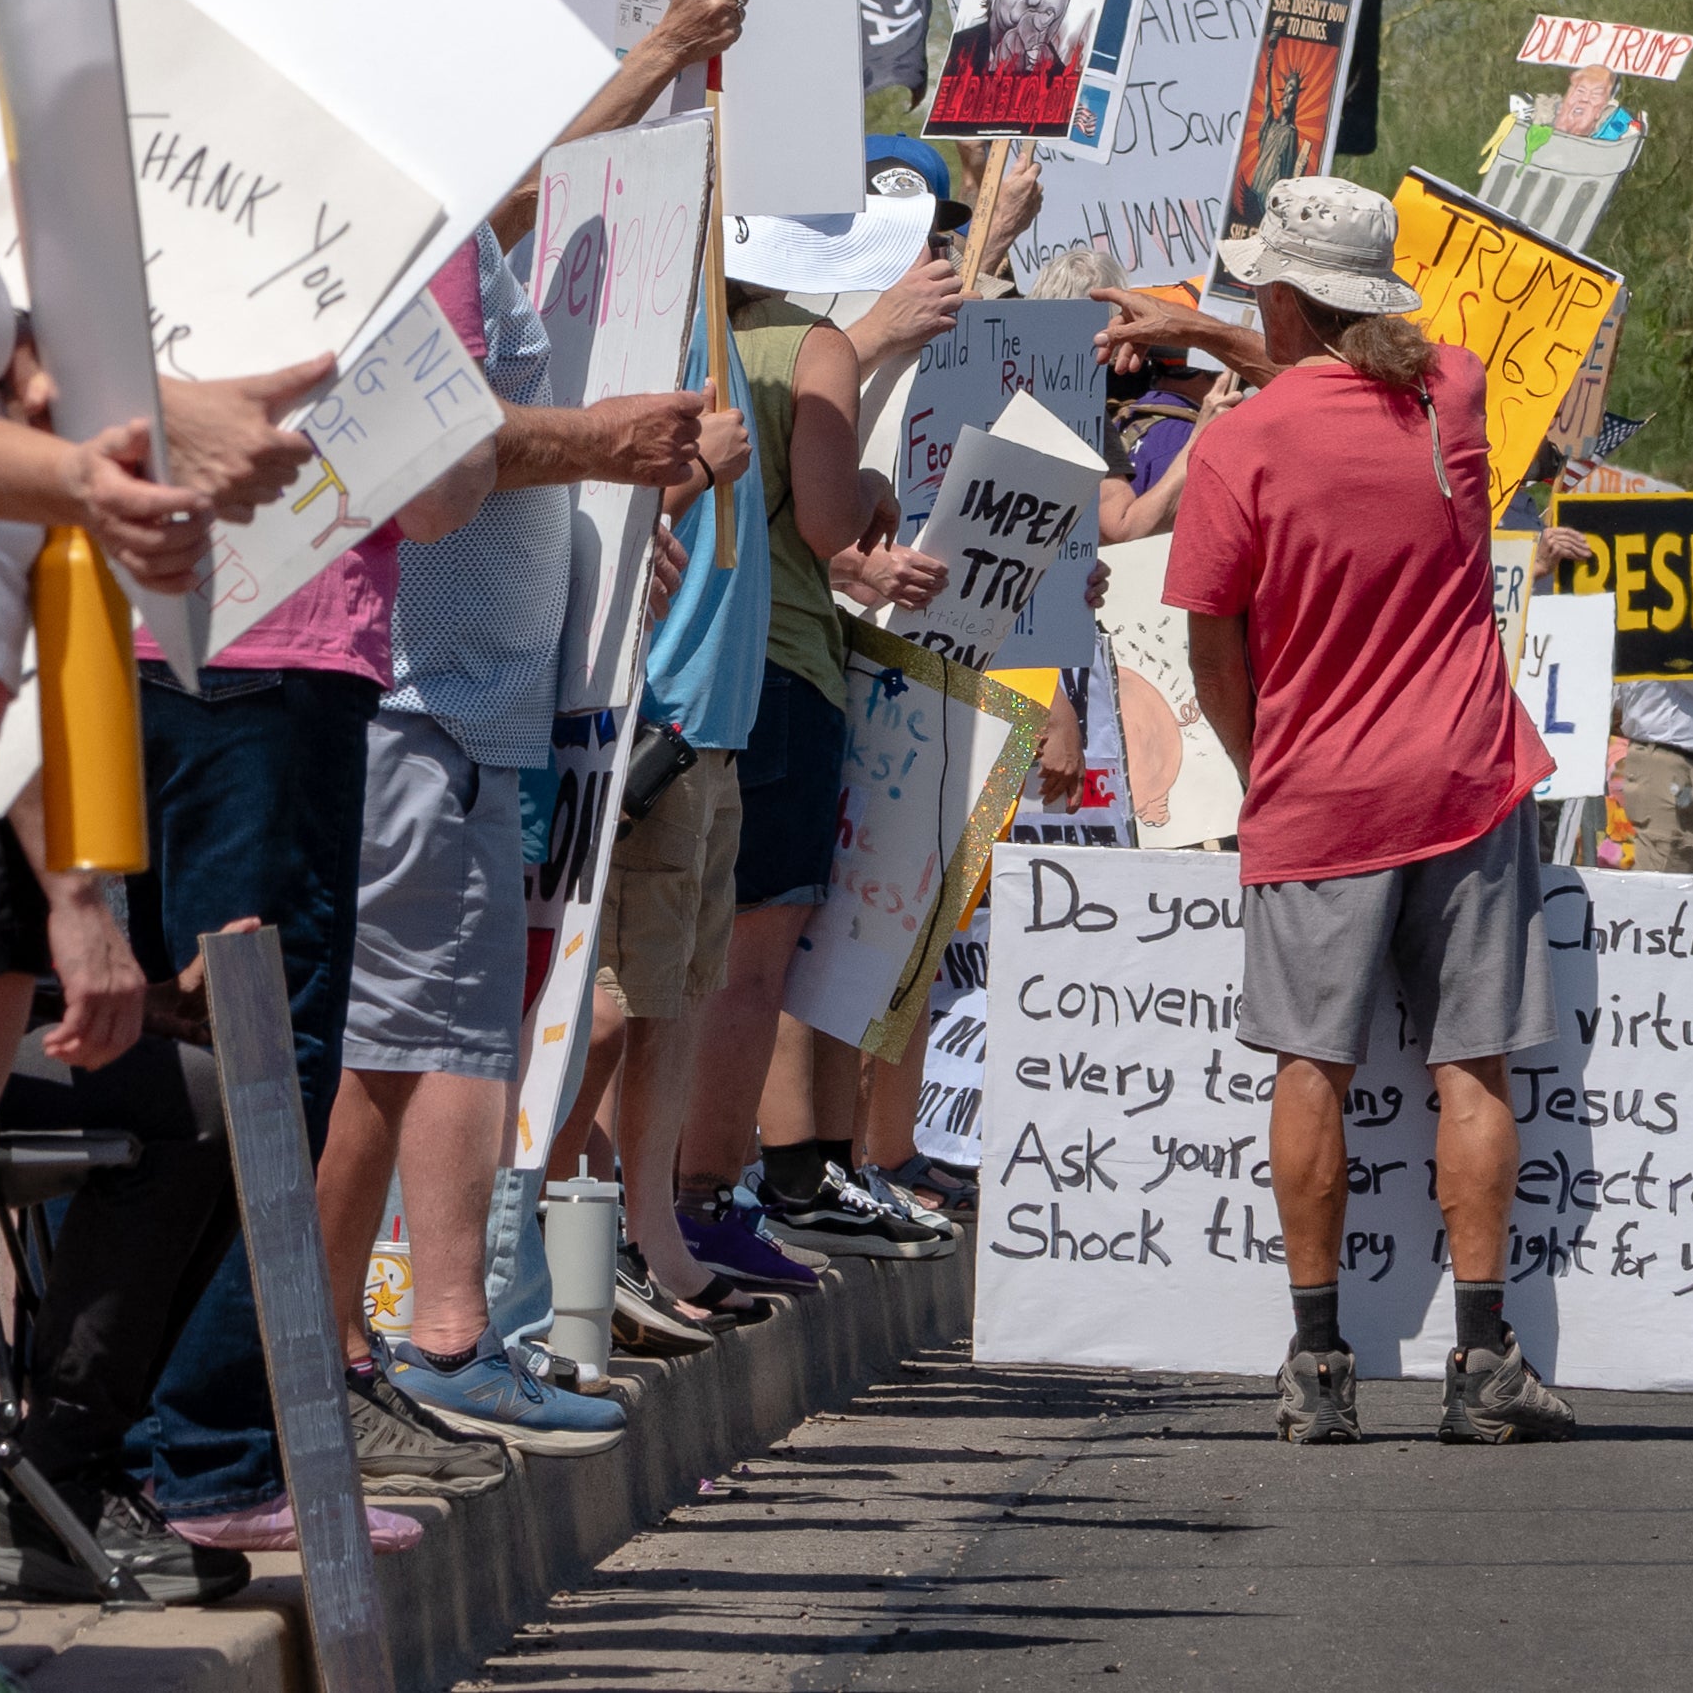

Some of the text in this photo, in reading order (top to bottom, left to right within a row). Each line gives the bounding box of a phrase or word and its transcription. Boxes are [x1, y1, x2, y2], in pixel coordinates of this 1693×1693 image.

[1286, 15, 1300, 37] TO
[1326, 1, 1348, 23] BOW
[1519, 16, 1693, 78] DUMP TRUMP
[125, 112, 282, 237] THANK
[532, 156, 688, 331] Believe
[1432, 204, 1603, 332] TRUMP
[983, 317, 1022, 362] The
[1001, 345, 1104, 399] Red Wall?
[1559, 376, 1601, 438] UT
[908, 407, 953, 479] Fea
[958, 478, 1079, 548] IMPEA
[960, 547, 1047, 615] TRU
[1058, 539, 1094, 561] hem
[1024, 857, 1119, 934] Do
[944, 941, 990, 990] NO
[1017, 973, 1245, 1033] conveni
[915, 1081, 959, 1129] OT
[1015, 1051, 1175, 1118] every
[1000, 1121, 1119, 1193] Ask
[1140, 1134, 1257, 1192] your
[989, 1202, 1173, 1266] Shock
[1509, 1224, 1597, 1283] ight
[1611, 1220, 1657, 1280] for
